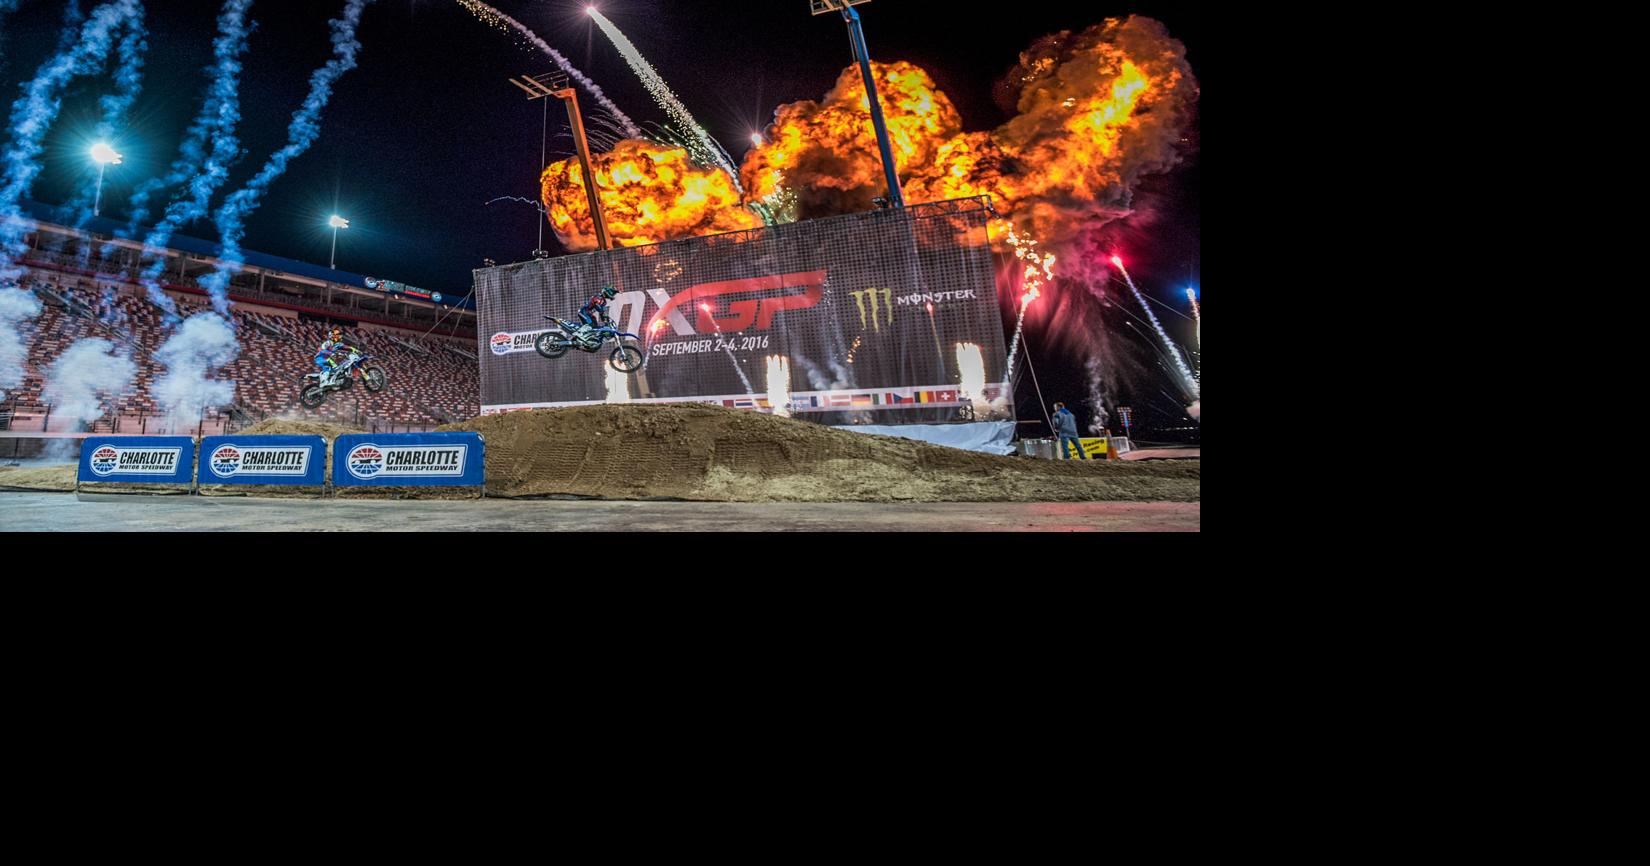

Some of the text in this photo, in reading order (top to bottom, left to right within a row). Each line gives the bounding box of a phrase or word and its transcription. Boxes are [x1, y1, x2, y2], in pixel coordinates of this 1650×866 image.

[896, 290, 977, 305] MONSTER
[652, 339, 713, 357] SEPTEMBER
[740, 335, 770, 351] 2016
[120, 451, 176, 465] CHARLOTTE
[242, 451, 305, 465] CHARLOTTE
[386, 450, 460, 466] CHARLOTTE
